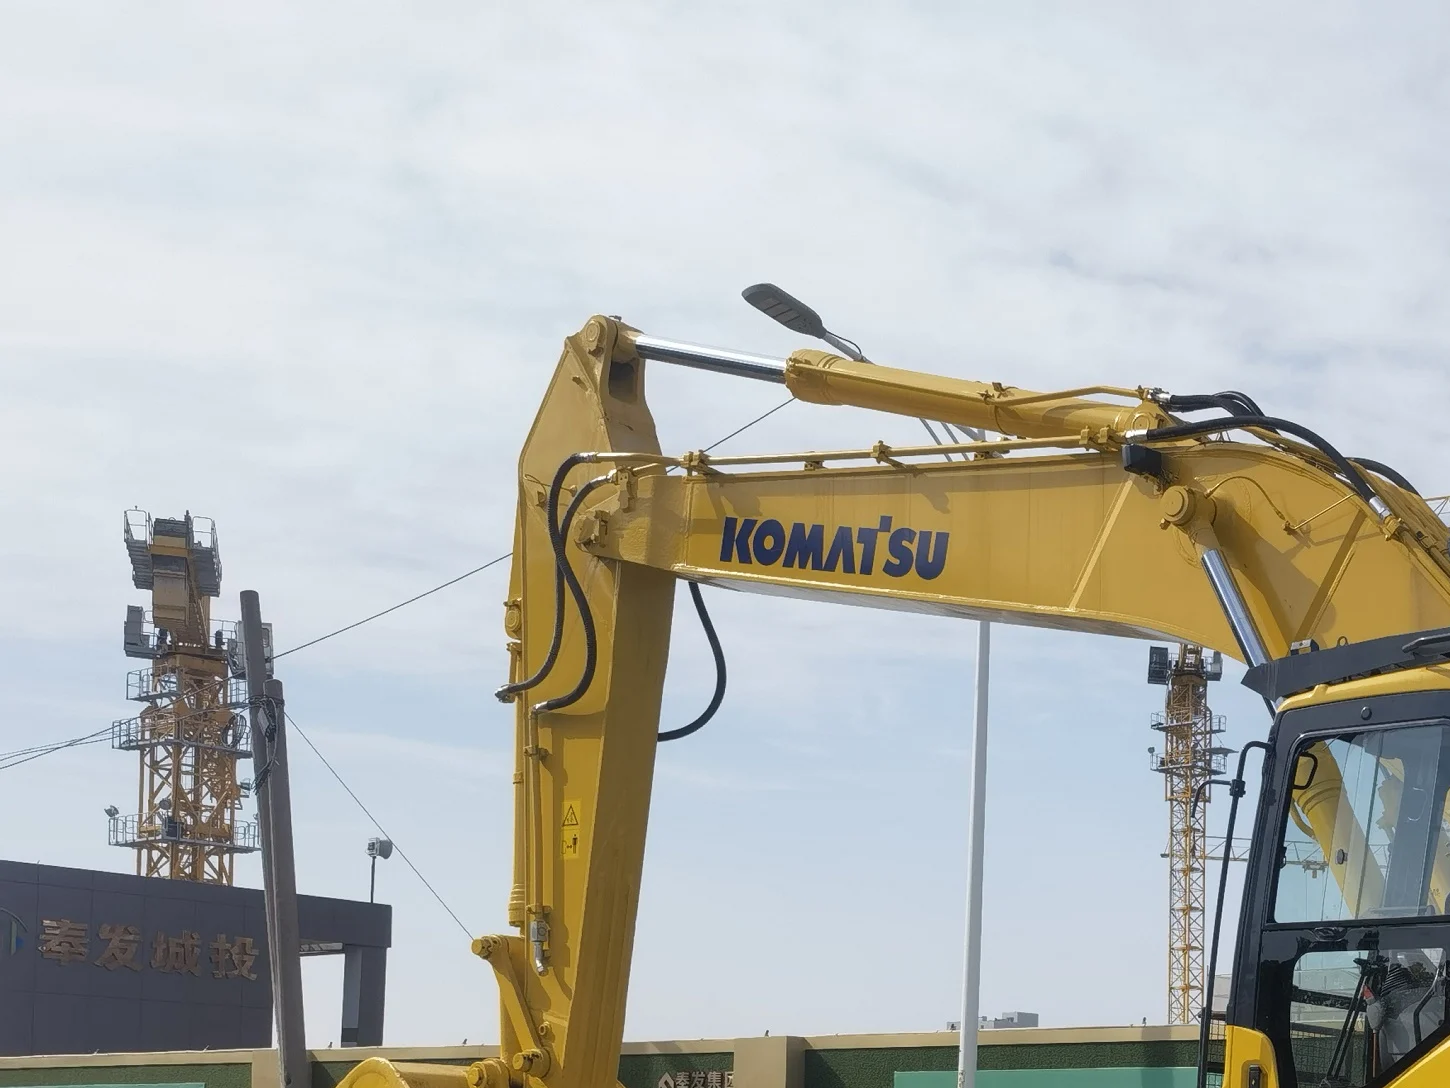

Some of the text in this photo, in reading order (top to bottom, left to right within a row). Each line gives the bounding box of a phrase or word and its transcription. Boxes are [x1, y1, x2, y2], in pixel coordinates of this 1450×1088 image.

[719, 515, 950, 581] KOMATSU
[38, 919, 260, 981] 奉发城投
